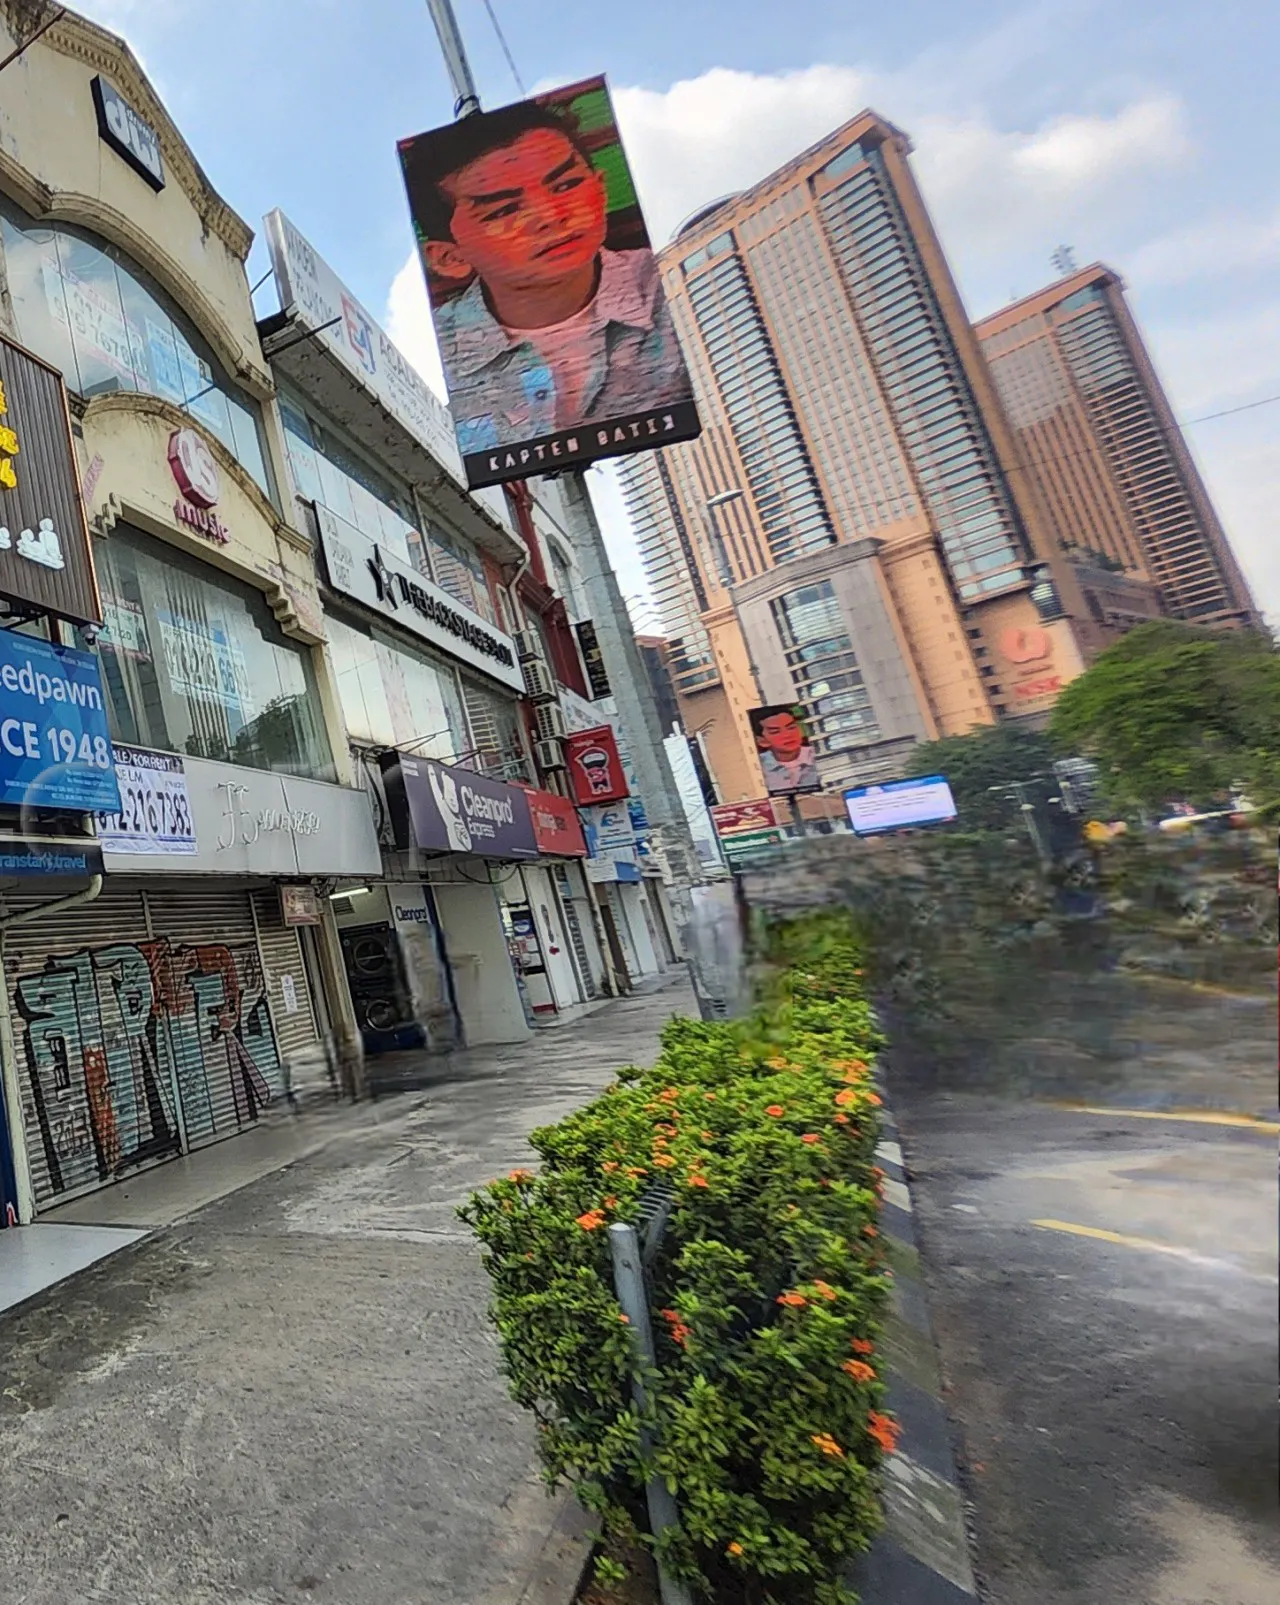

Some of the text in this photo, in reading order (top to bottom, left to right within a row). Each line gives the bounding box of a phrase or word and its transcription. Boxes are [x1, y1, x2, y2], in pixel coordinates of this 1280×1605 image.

[47, 727, 110, 770] 1948
[460, 786, 512, 827] Cleanpro
[54, 854, 87, 870] travel
